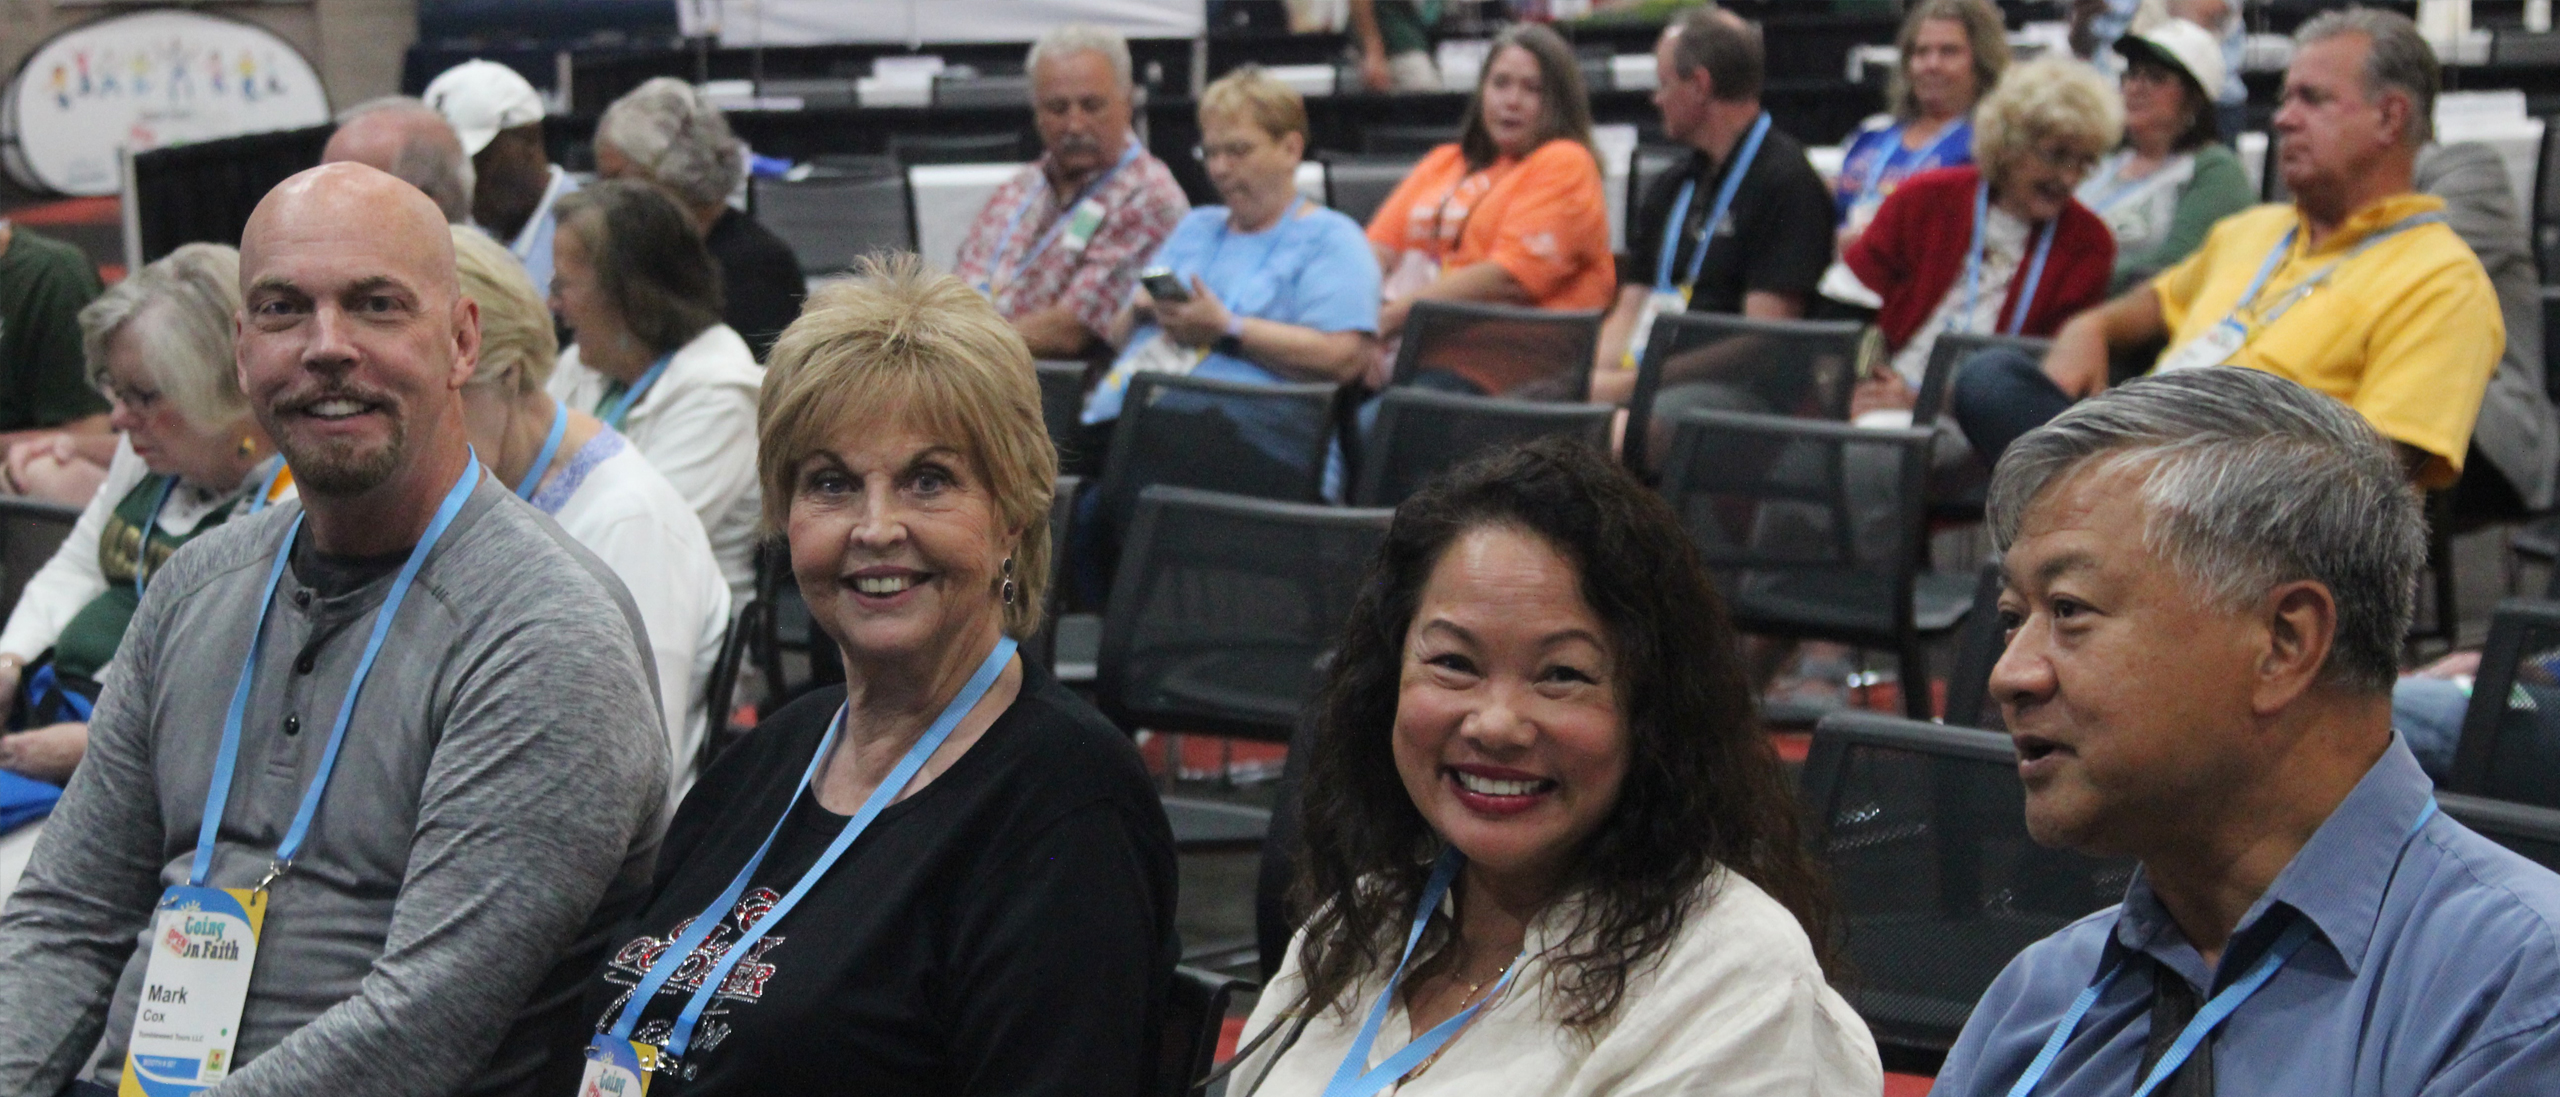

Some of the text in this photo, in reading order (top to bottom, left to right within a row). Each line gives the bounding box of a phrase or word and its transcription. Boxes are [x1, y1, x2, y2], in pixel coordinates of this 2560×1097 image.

[184, 915, 226, 942] Going
[201, 939, 239, 961] Faith
[147, 984, 188, 1005] Mark
[142, 1008, 165, 1023] Cox
